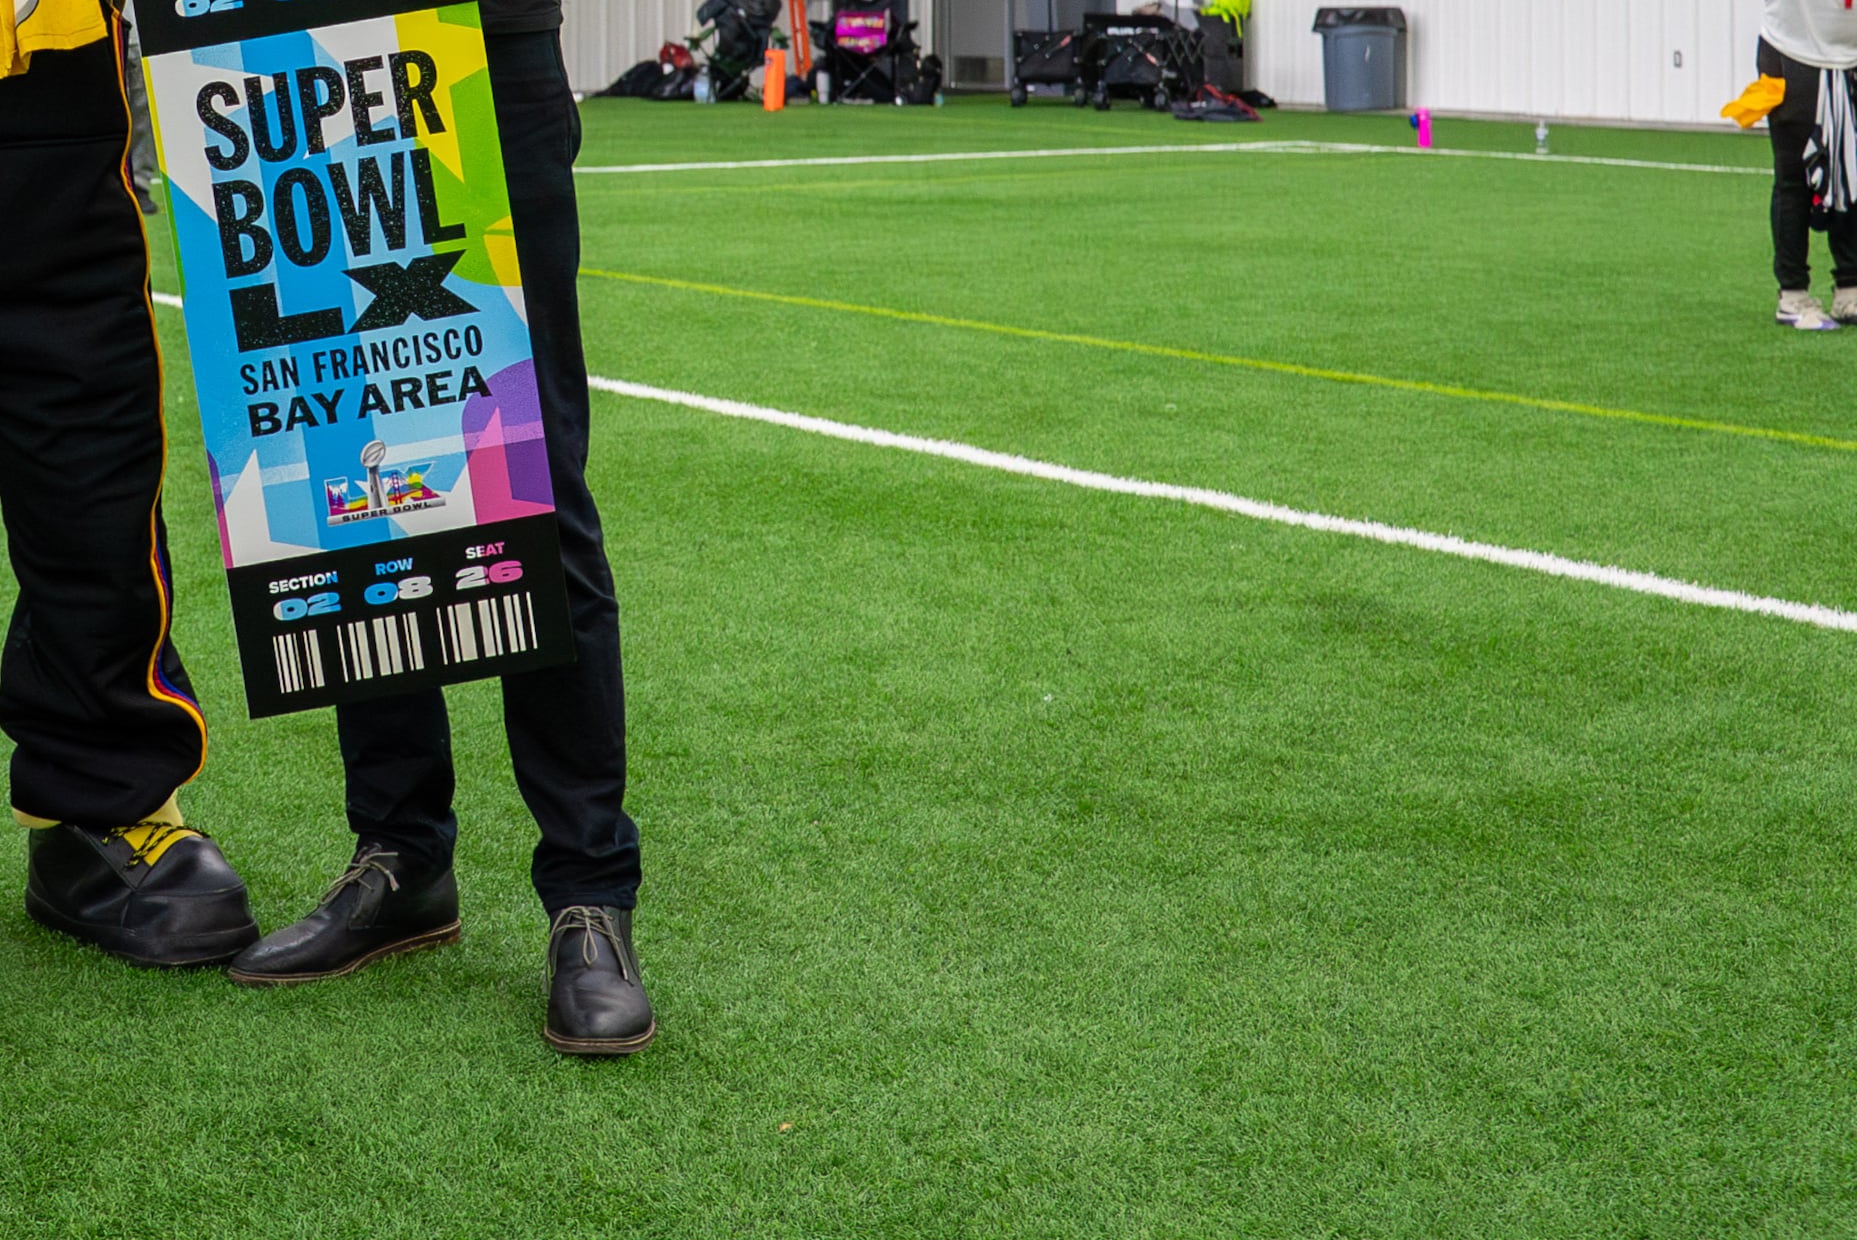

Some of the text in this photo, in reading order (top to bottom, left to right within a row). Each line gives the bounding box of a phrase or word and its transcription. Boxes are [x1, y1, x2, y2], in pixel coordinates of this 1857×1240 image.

[196, 49, 446, 171] SUPER
[212, 147, 466, 279] BOWL
[229, 249, 481, 353] LX
[239, 324, 483, 395] SAN FRANCISCO
[247, 365, 493, 437] BAY AREA
[342, 501, 433, 522] SUPER BOWL
[268, 541, 505, 594] SECTION ROW SEAT
[272, 560, 524, 621] 02 08 26
